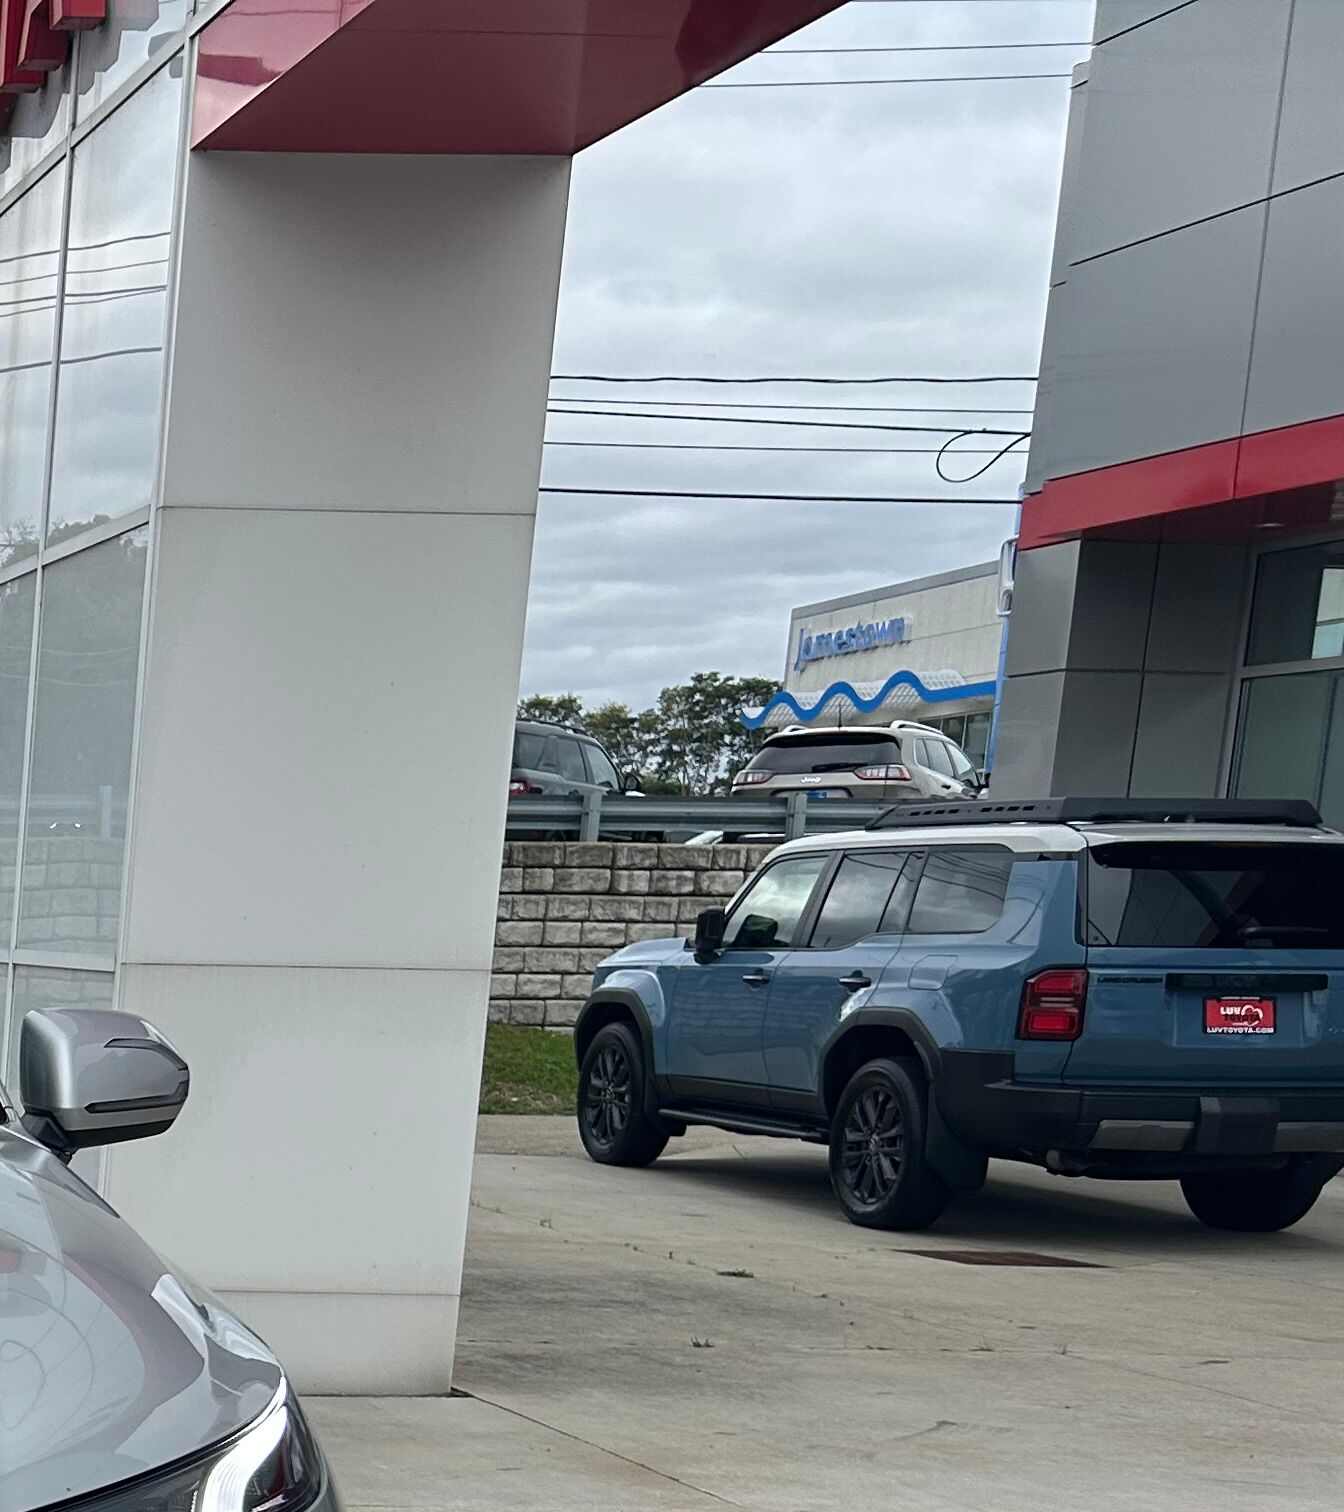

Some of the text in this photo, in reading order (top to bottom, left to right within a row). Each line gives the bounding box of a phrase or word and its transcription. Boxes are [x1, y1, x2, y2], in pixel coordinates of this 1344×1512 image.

[794, 616, 909, 672] Jamestown
[1219, 1006, 1242, 1015] LUV
[1206, 1026, 1274, 1034] LUVTOYOTA.COM
